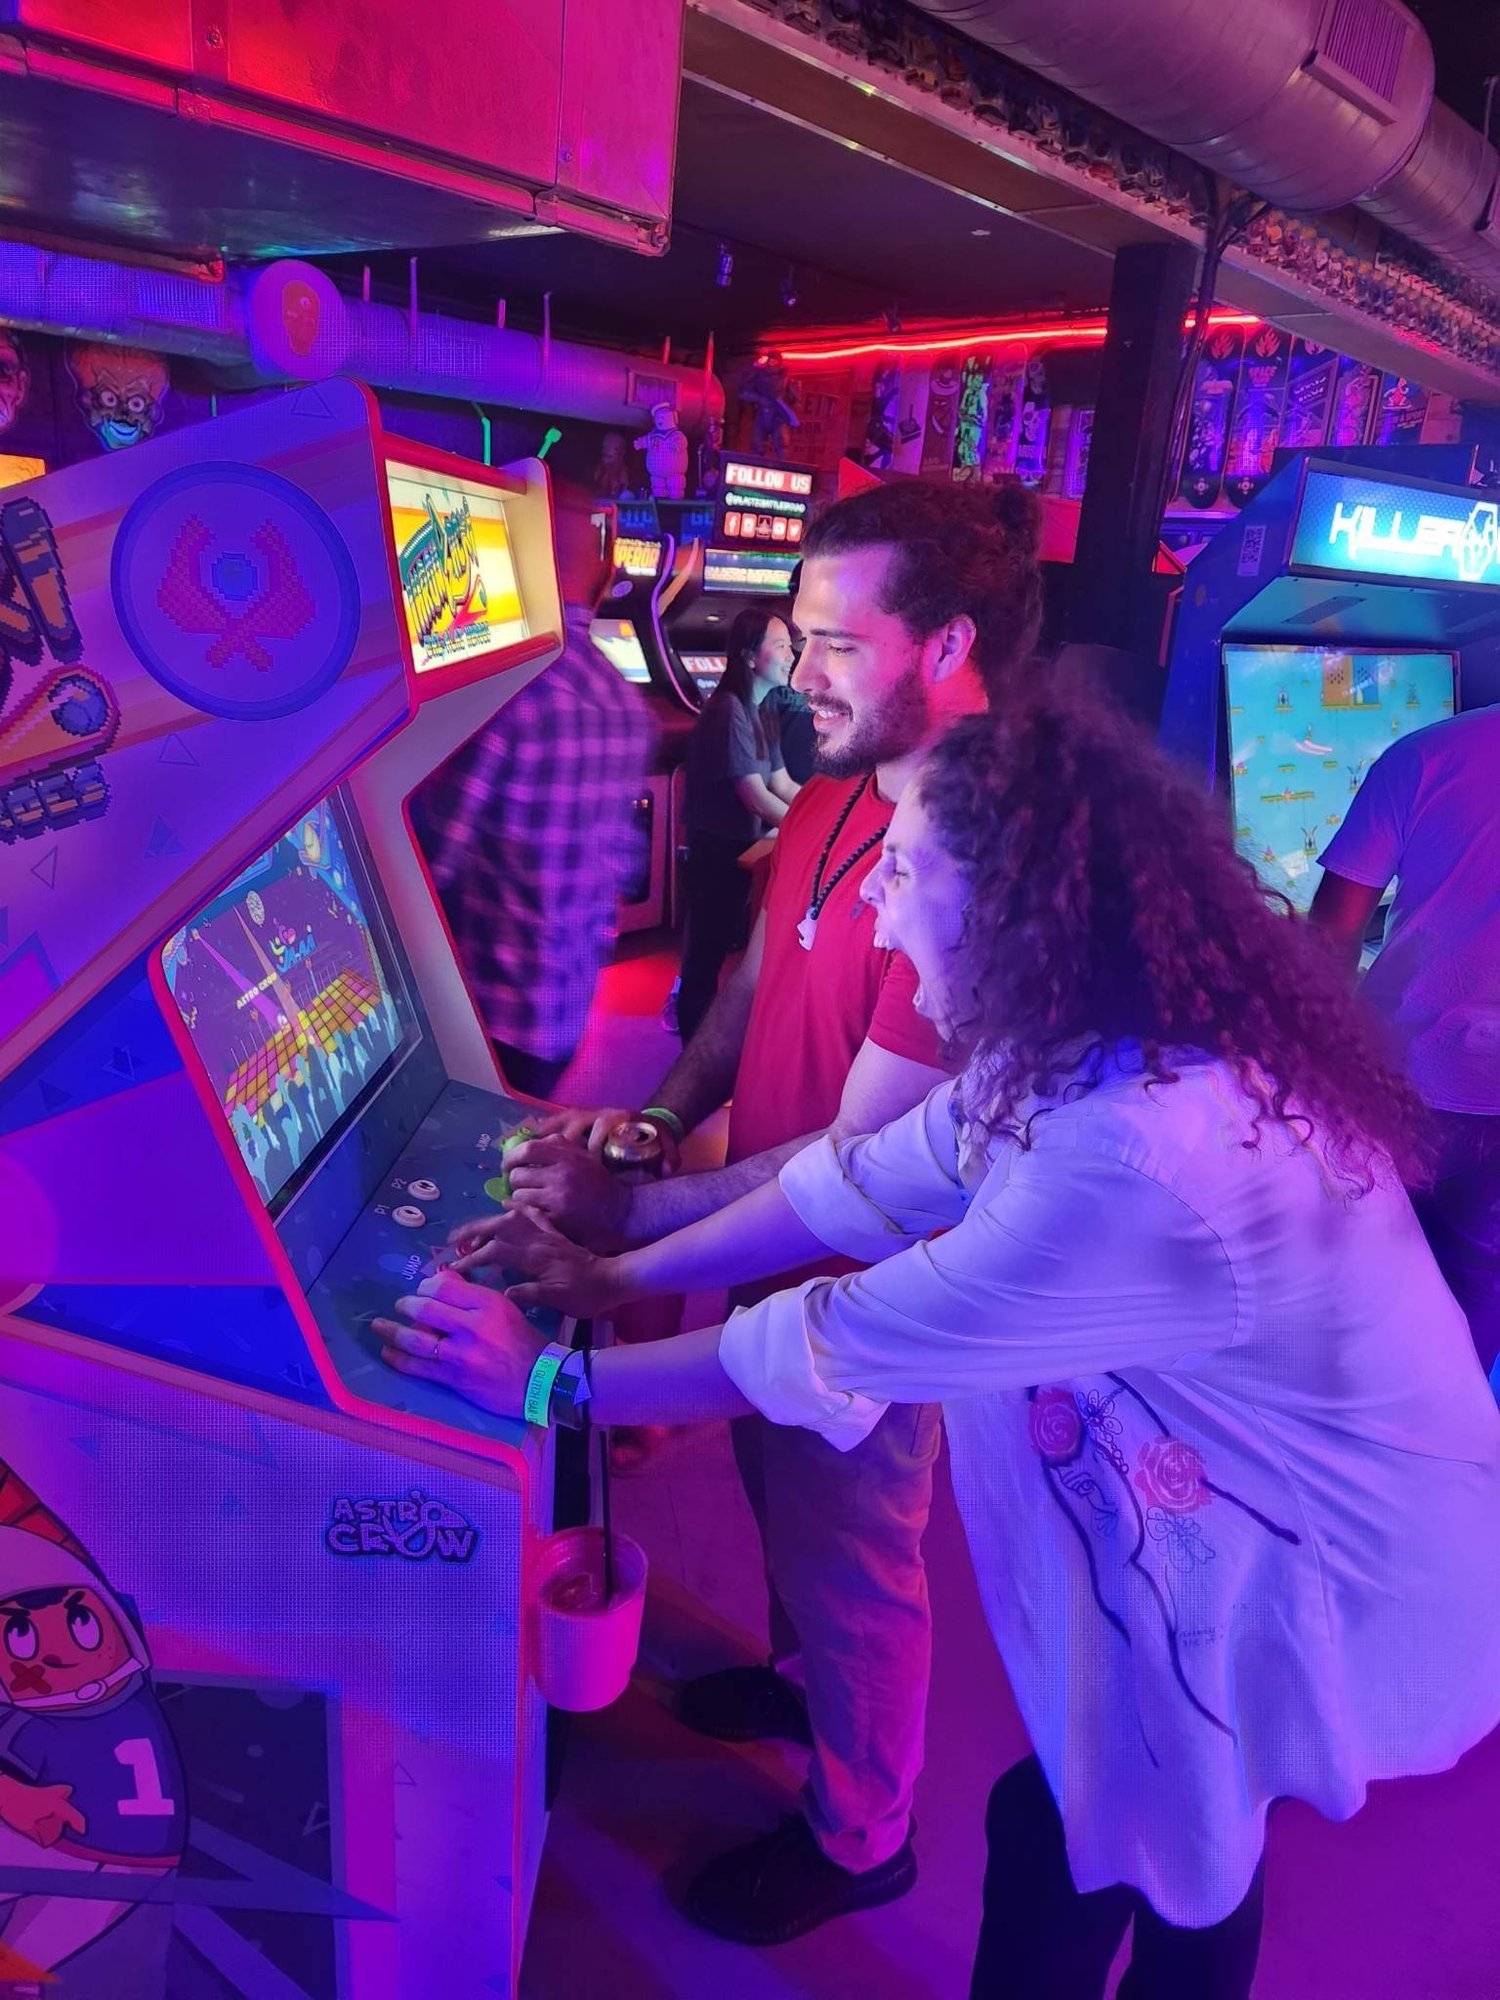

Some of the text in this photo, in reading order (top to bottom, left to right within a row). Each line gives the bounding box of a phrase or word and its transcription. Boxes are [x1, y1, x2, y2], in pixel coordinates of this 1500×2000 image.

[725, 463, 811, 492] FOLLOW US
[1329, 502, 1466, 560] KILLER
[236, 986, 260, 1010] ASTRO
[391, 1177, 408, 1190] P2
[374, 1203, 391, 1216] P1
[400, 1254, 423, 1281] JUMP
[529, 1369, 546, 1400] GLITCH
[334, 1493, 458, 1525] ASTRO
[327, 1519, 475, 1559] CROW
[113, 1738, 176, 1817] 1
